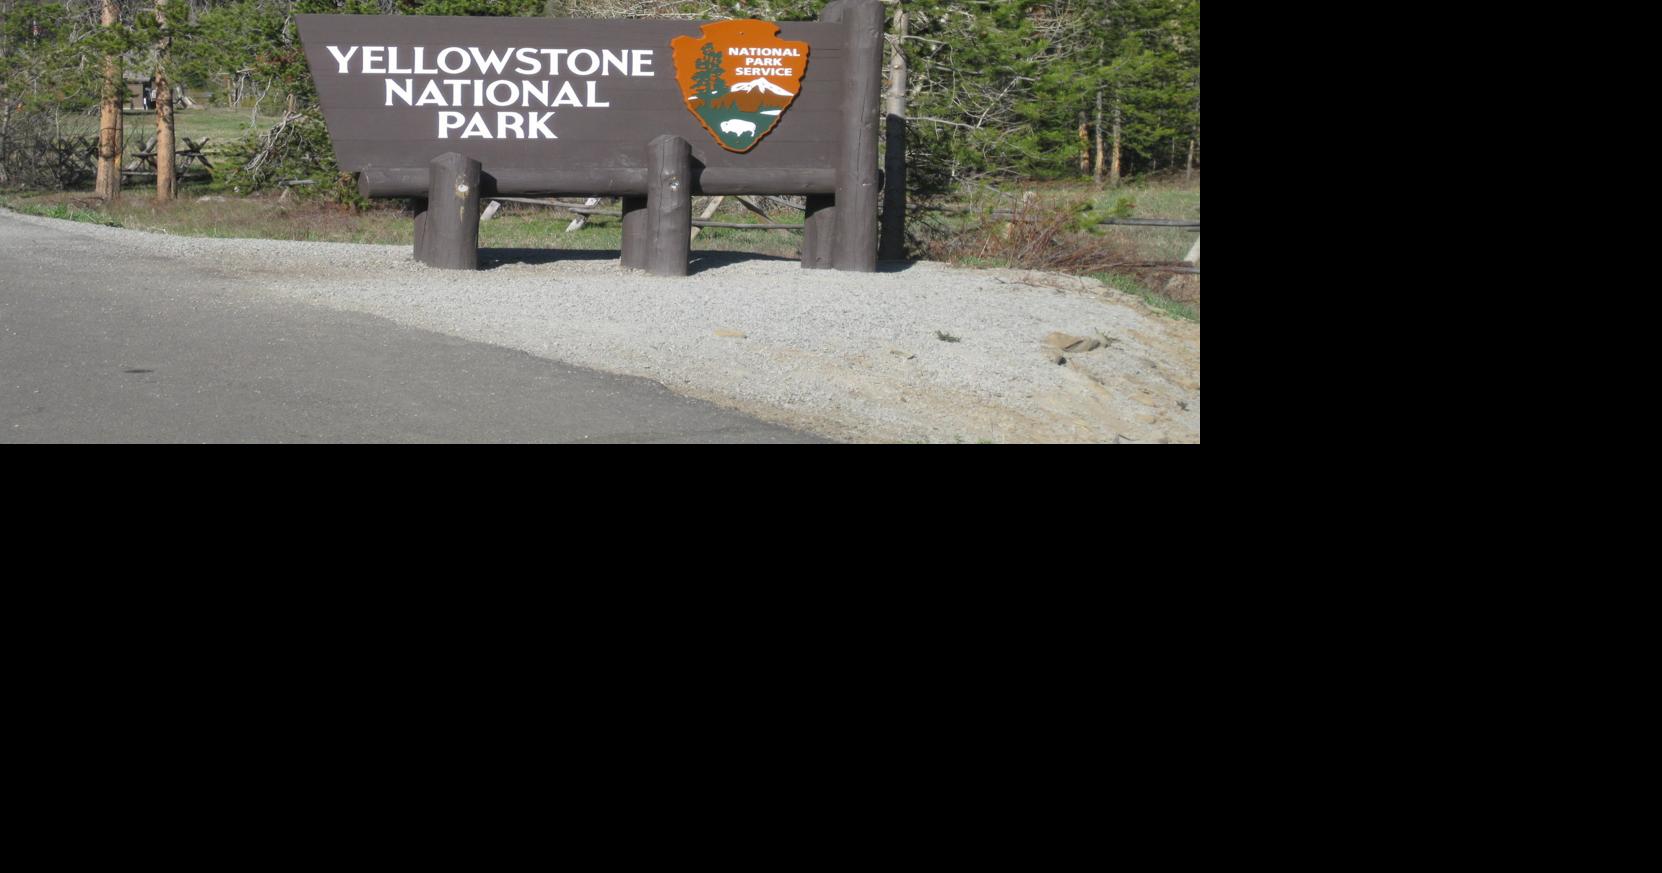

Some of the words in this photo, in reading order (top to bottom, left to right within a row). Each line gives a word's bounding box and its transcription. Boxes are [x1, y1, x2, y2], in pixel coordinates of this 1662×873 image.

[326, 45, 655, 77] YELLOWSTONE
[728, 47, 800, 57] NATIONAL
[745, 57, 782, 66] PARK
[735, 67, 793, 76] SERVICE
[384, 79, 610, 108] NATIONAL
[437, 110, 559, 139] PARK
